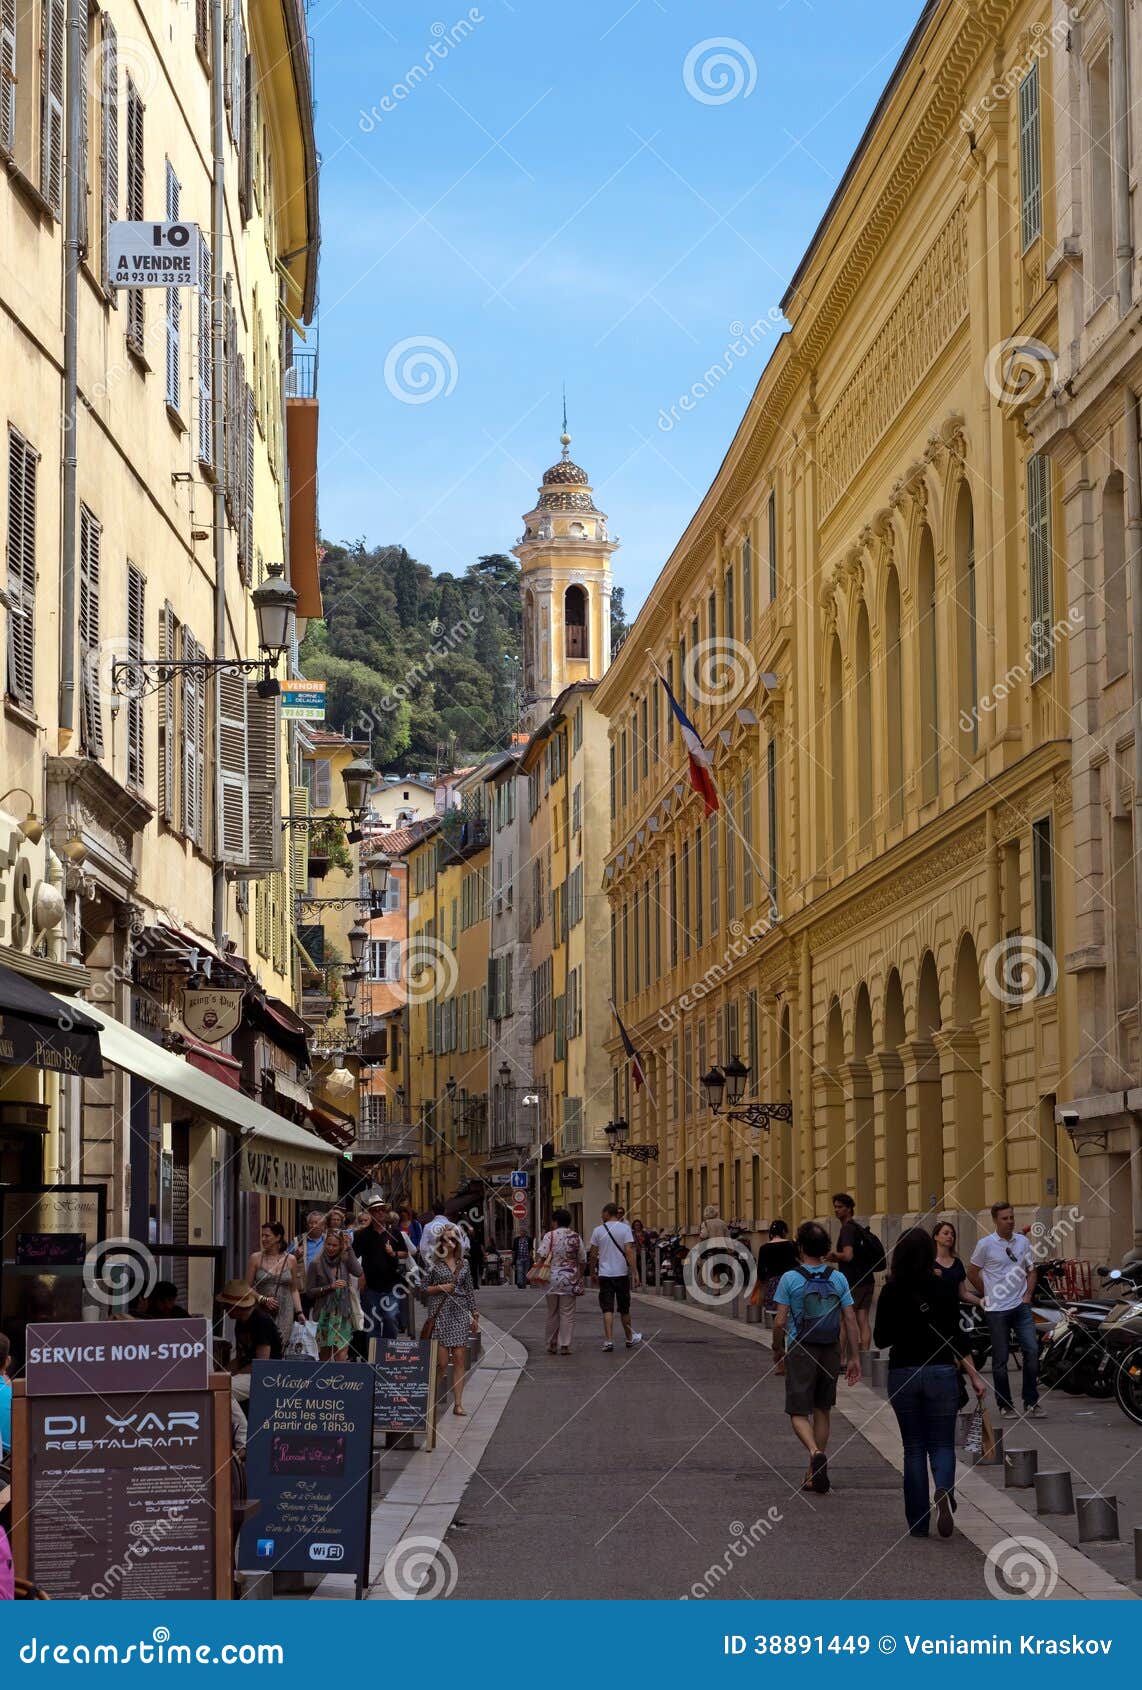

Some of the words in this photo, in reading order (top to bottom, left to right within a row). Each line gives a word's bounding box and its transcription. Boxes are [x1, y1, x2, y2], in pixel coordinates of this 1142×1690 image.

[118, 255, 129, 270] A
[132, 255, 191, 271] VENDRE
[116, 272, 129, 282] 04
[132, 272, 144, 282] 93
[147, 272, 158, 282] 01
[162, 273, 174, 283] 33
[177, 273, 191, 283] 52
[287, 682, 325, 691] VENDRE
[35, 1040, 62, 1068] Piano
[64, 1046, 82, 1072] Bar
[29, 1346, 106, 1365] SERVICE
[111, 1342, 206, 1362] NON-STOP
[262, 1374, 312, 1389] Master
[315, 1374, 365, 1391] Home
[276, 1398, 302, 1409] LIVE
[305, 1399, 345, 1410] MUSIC
[274, 1410, 297, 1419] tous
[300, 1410, 316, 1420] les
[319, 1411, 345, 1421] soirs
[44, 1415, 86, 1436] DI
[273, 1420, 302, 1432] partir
[304, 1421, 318, 1431] de
[322, 1421, 355, 1433] 18h30
[45, 1436, 199, 1451] RESTAURANT
